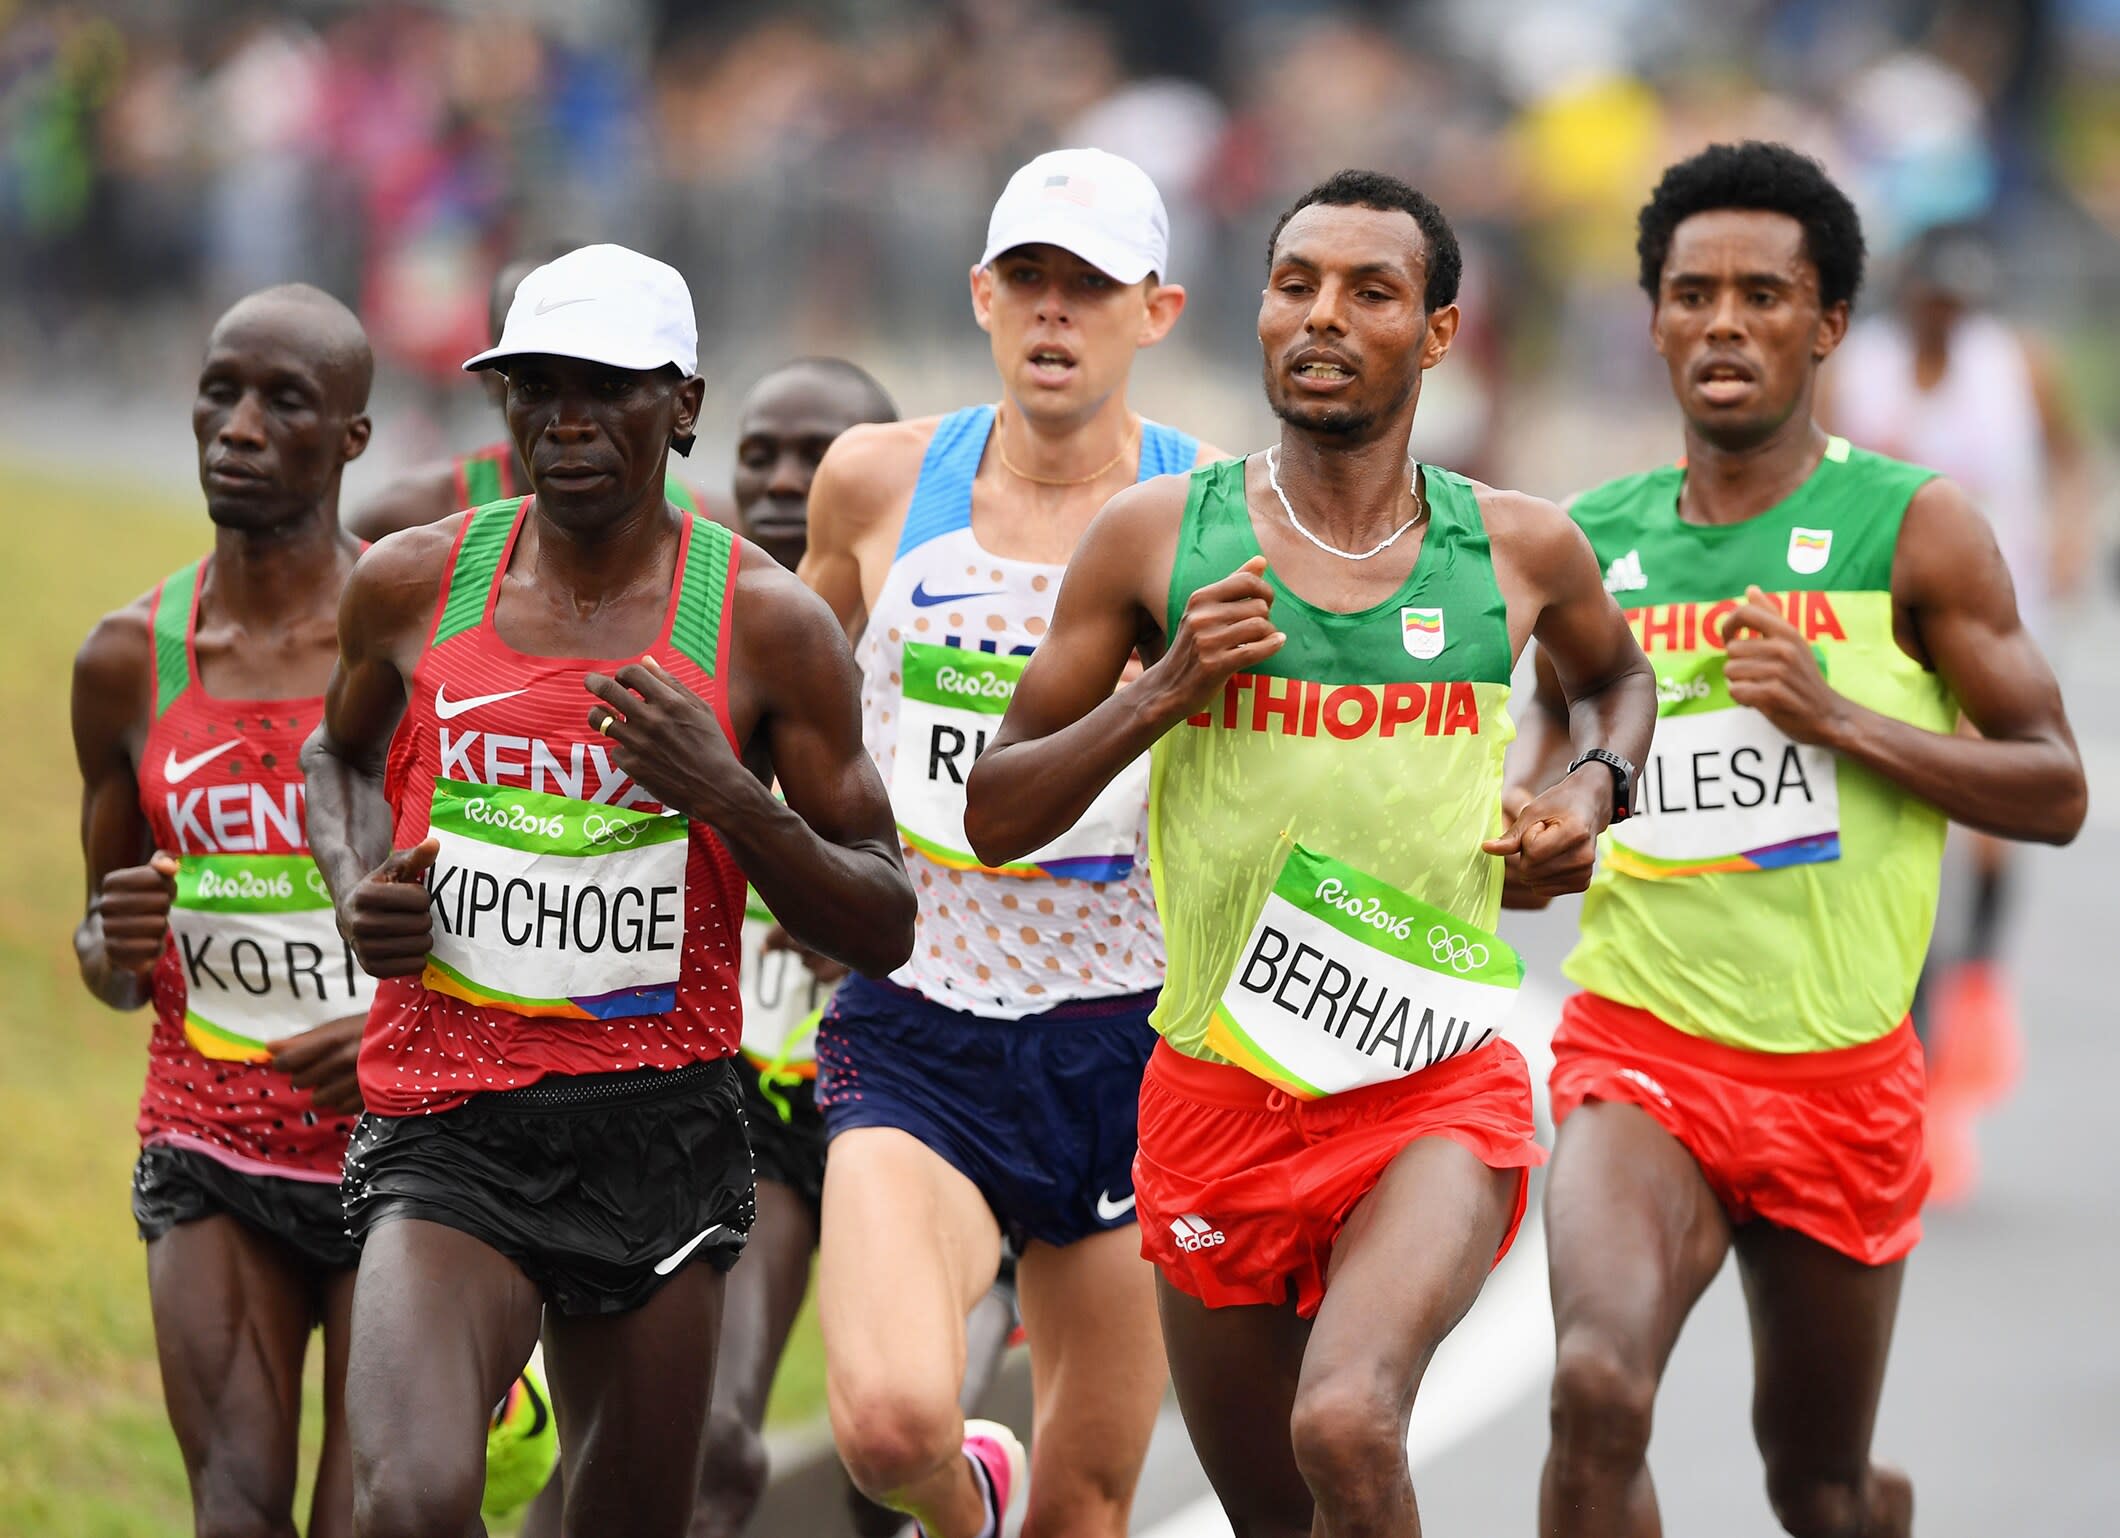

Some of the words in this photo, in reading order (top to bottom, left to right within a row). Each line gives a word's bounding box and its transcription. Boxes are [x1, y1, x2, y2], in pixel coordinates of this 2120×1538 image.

[1624, 591, 1847, 652] HIOIA
[1632, 744, 1812, 816] ILESA
[167, 783, 309, 854] KEN
[464, 797, 564, 839] Rio2016
[197, 869, 293, 899] Rio2016
[428, 863, 677, 953] KIPCHOGE
[1313, 877, 1416, 941] Rio2016
